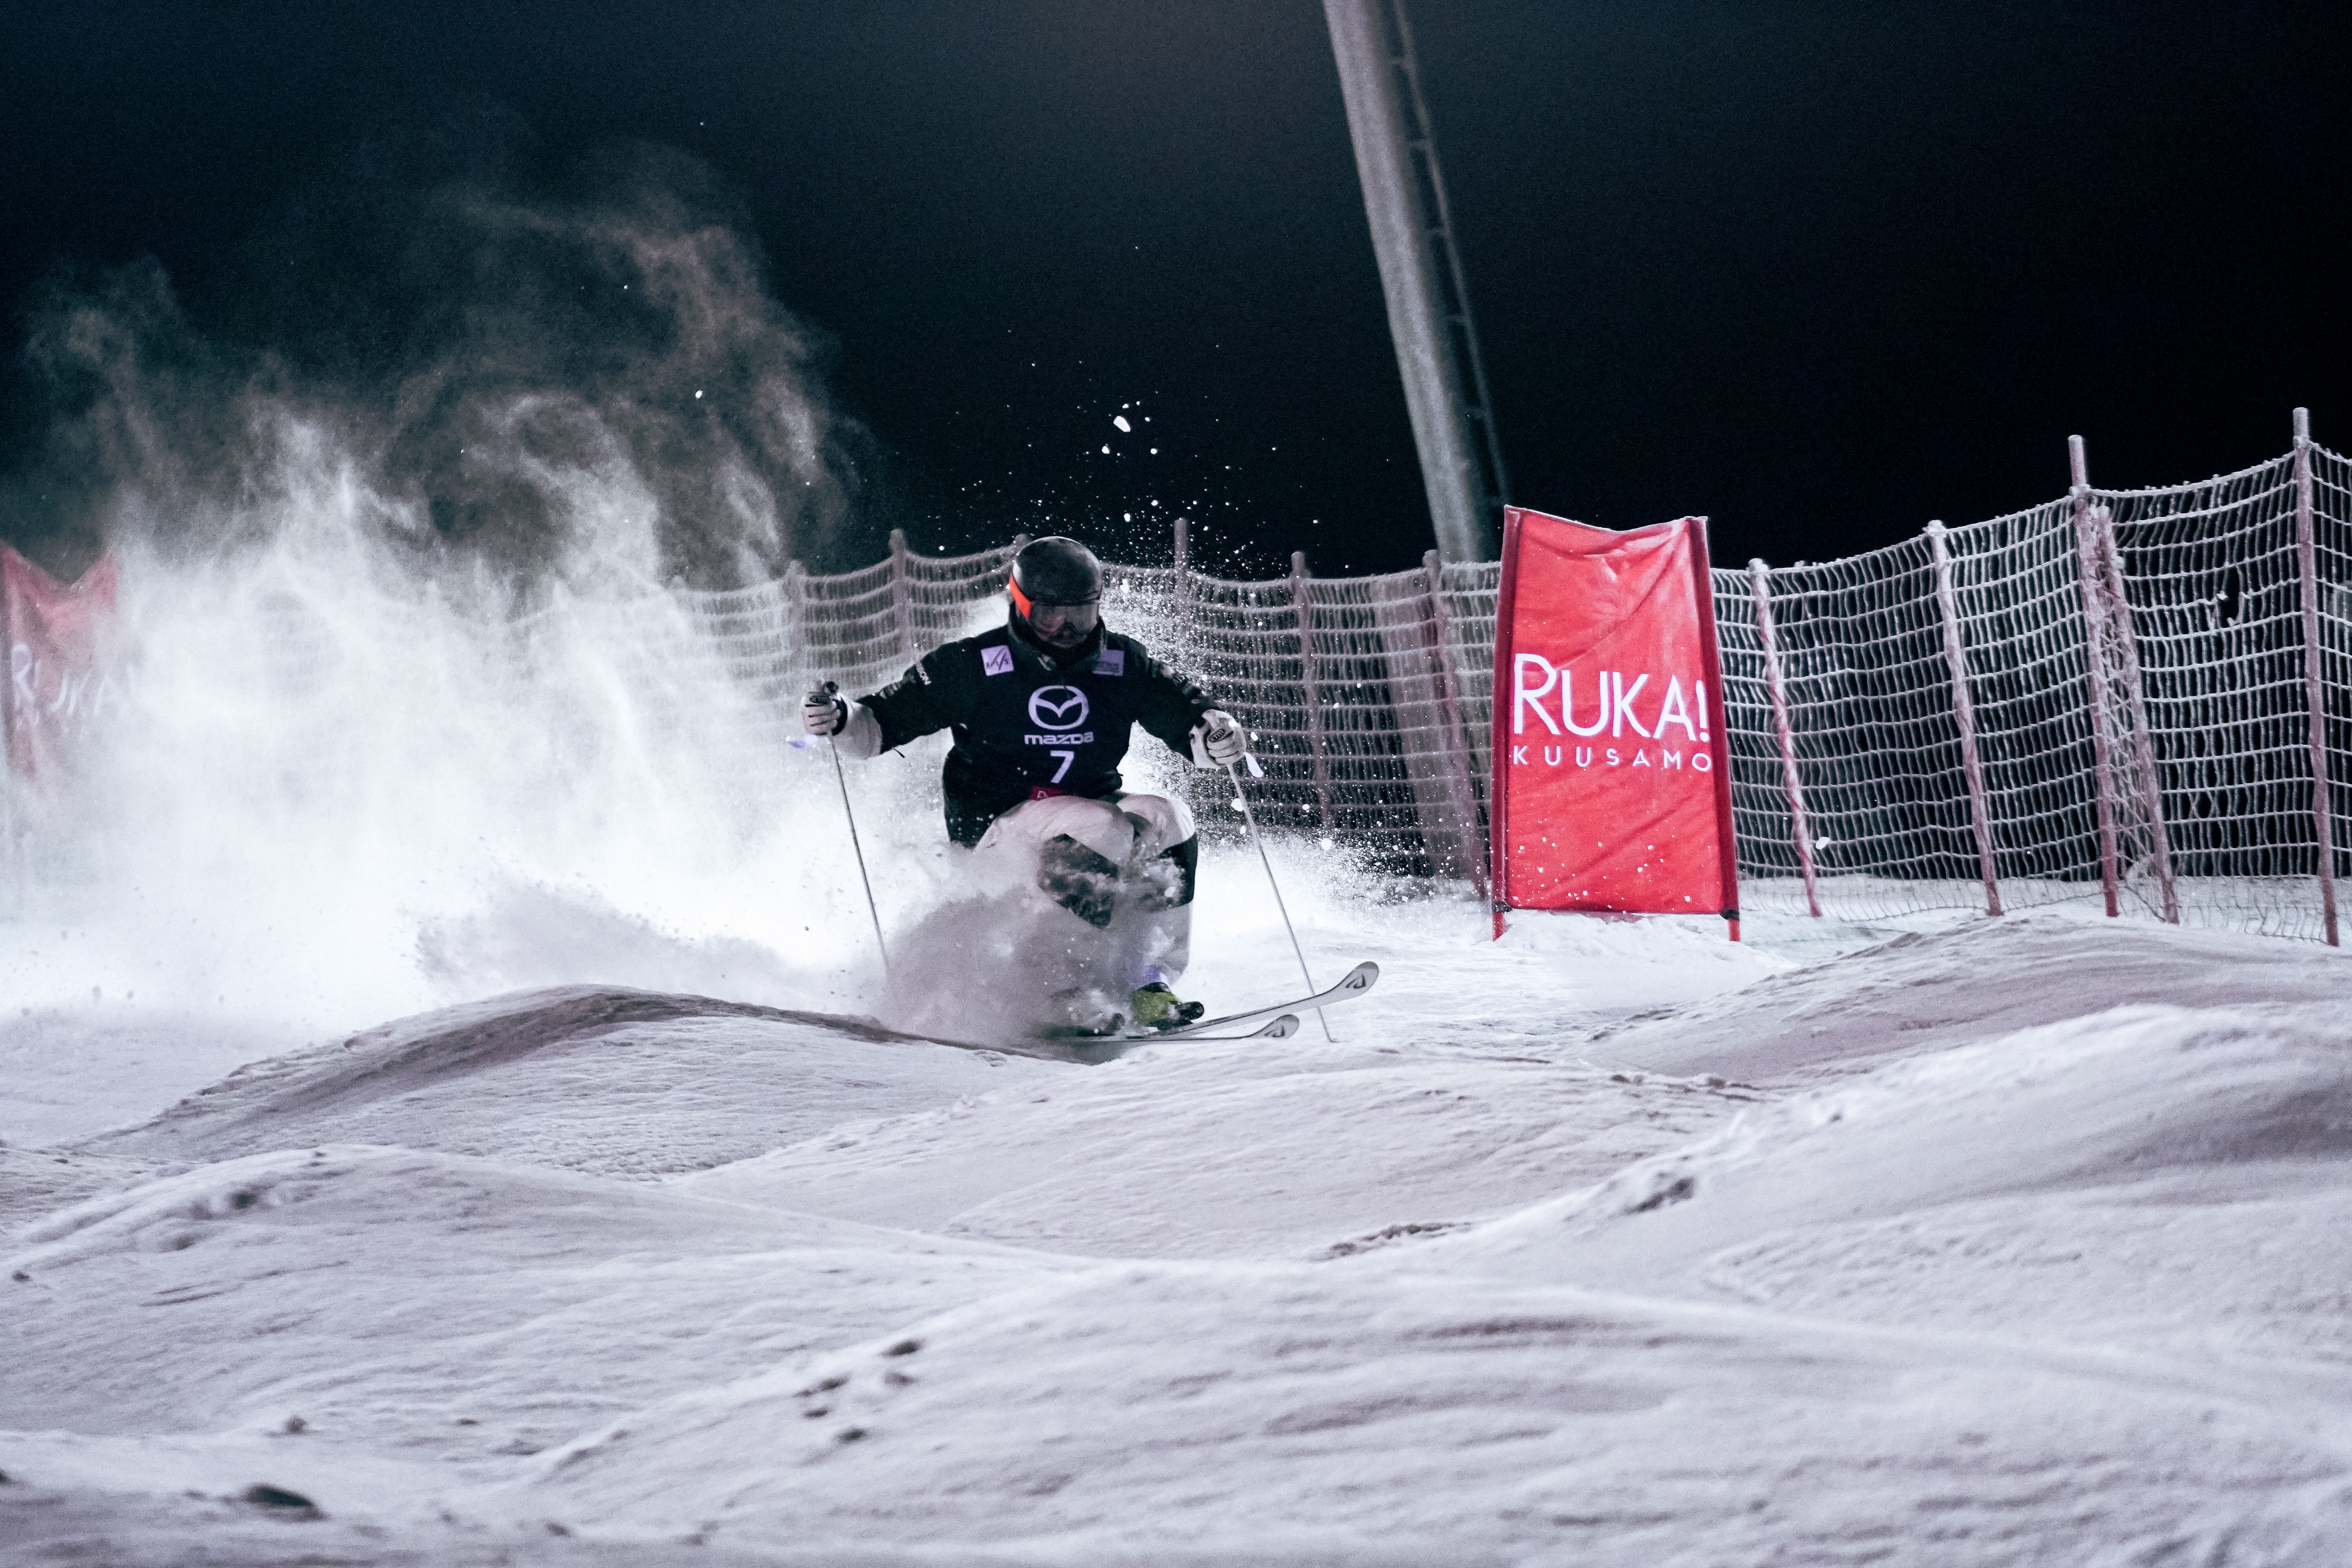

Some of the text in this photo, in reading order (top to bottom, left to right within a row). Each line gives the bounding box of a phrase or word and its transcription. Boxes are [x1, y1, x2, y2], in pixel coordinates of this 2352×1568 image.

[1514, 653, 1711, 743] RUKA!
[1024, 731, 1094, 745] mazda
[1050, 750, 1075, 784] 7
[1513, 745, 1712, 772] KUUSAMO
